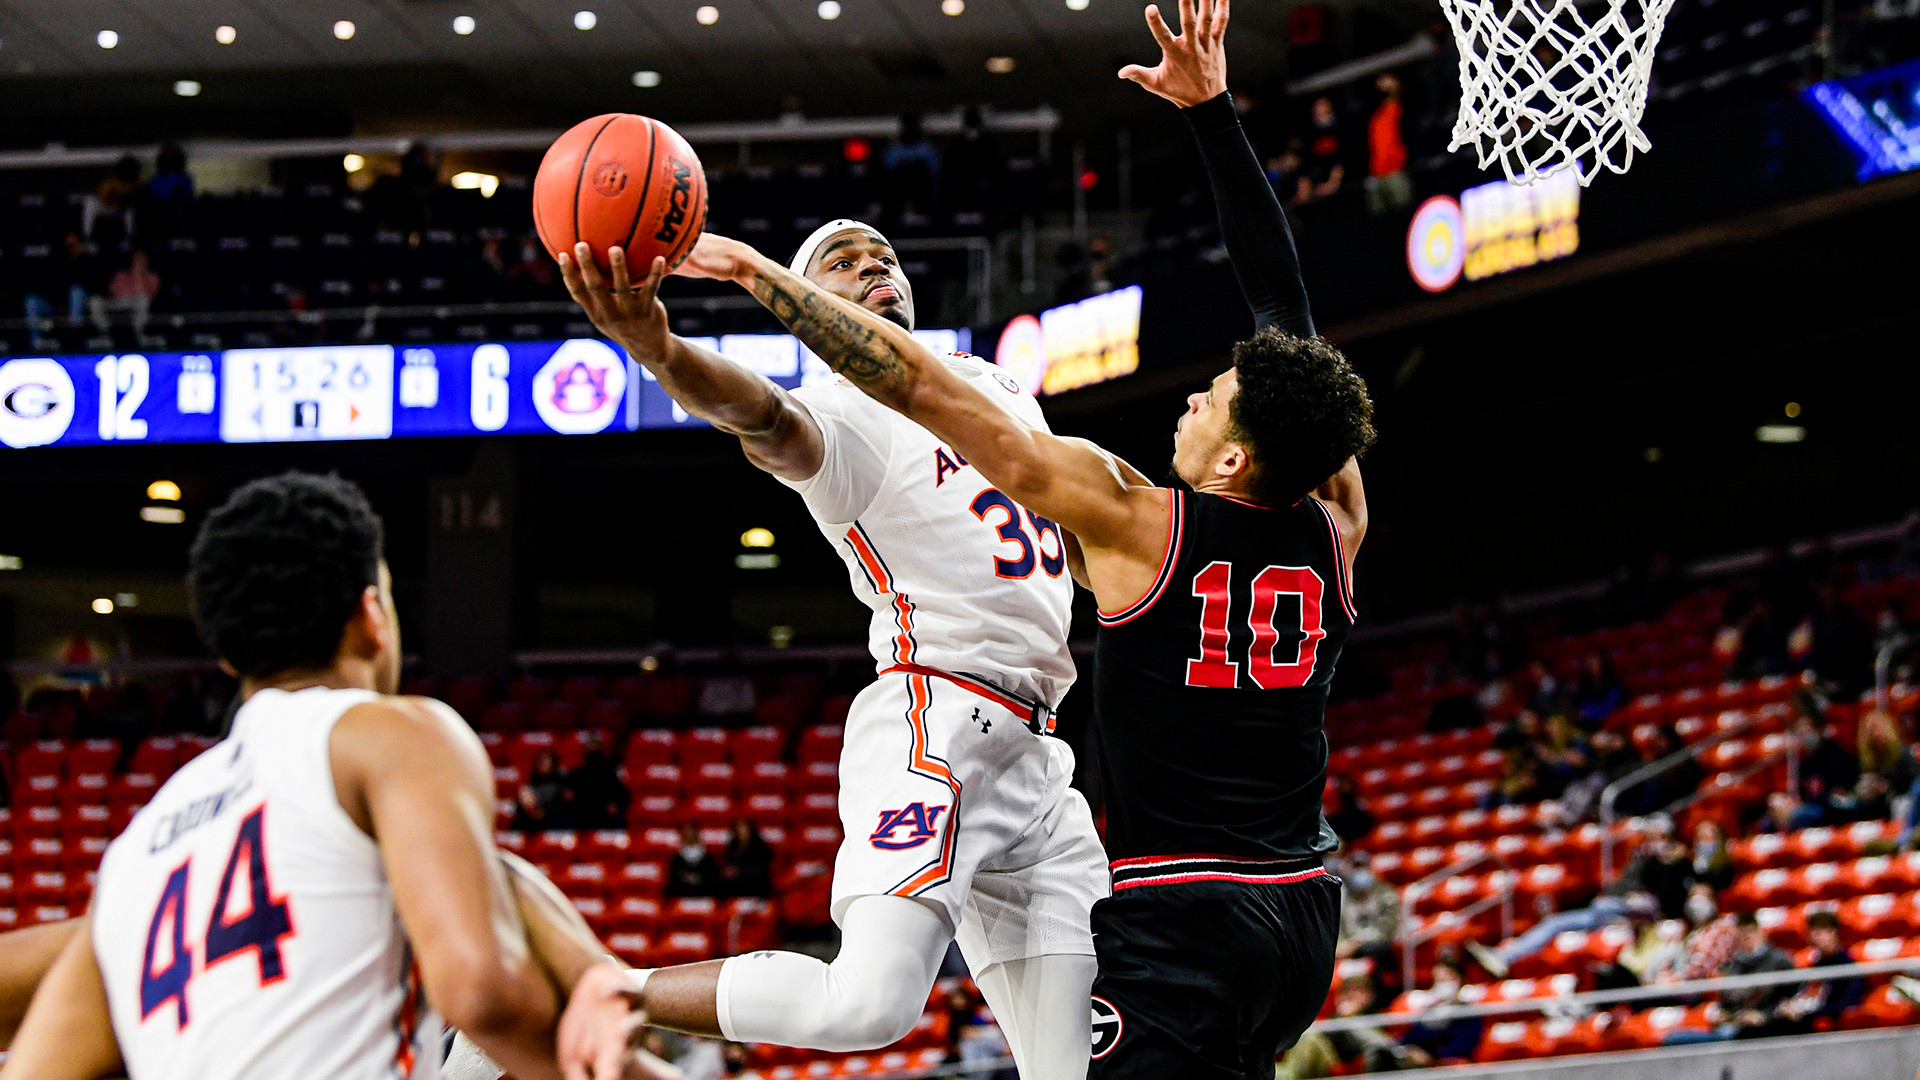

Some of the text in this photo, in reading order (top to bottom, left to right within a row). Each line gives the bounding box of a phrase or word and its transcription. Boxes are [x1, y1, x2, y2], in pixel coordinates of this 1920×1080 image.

[655, 160, 691, 243] NCAA
[95, 354, 150, 440] 12
[471, 344, 509, 430] 6
[440, 494, 502, 529] 114
[1185, 560, 1327, 690] 10
[138, 799, 296, 1034] 44
